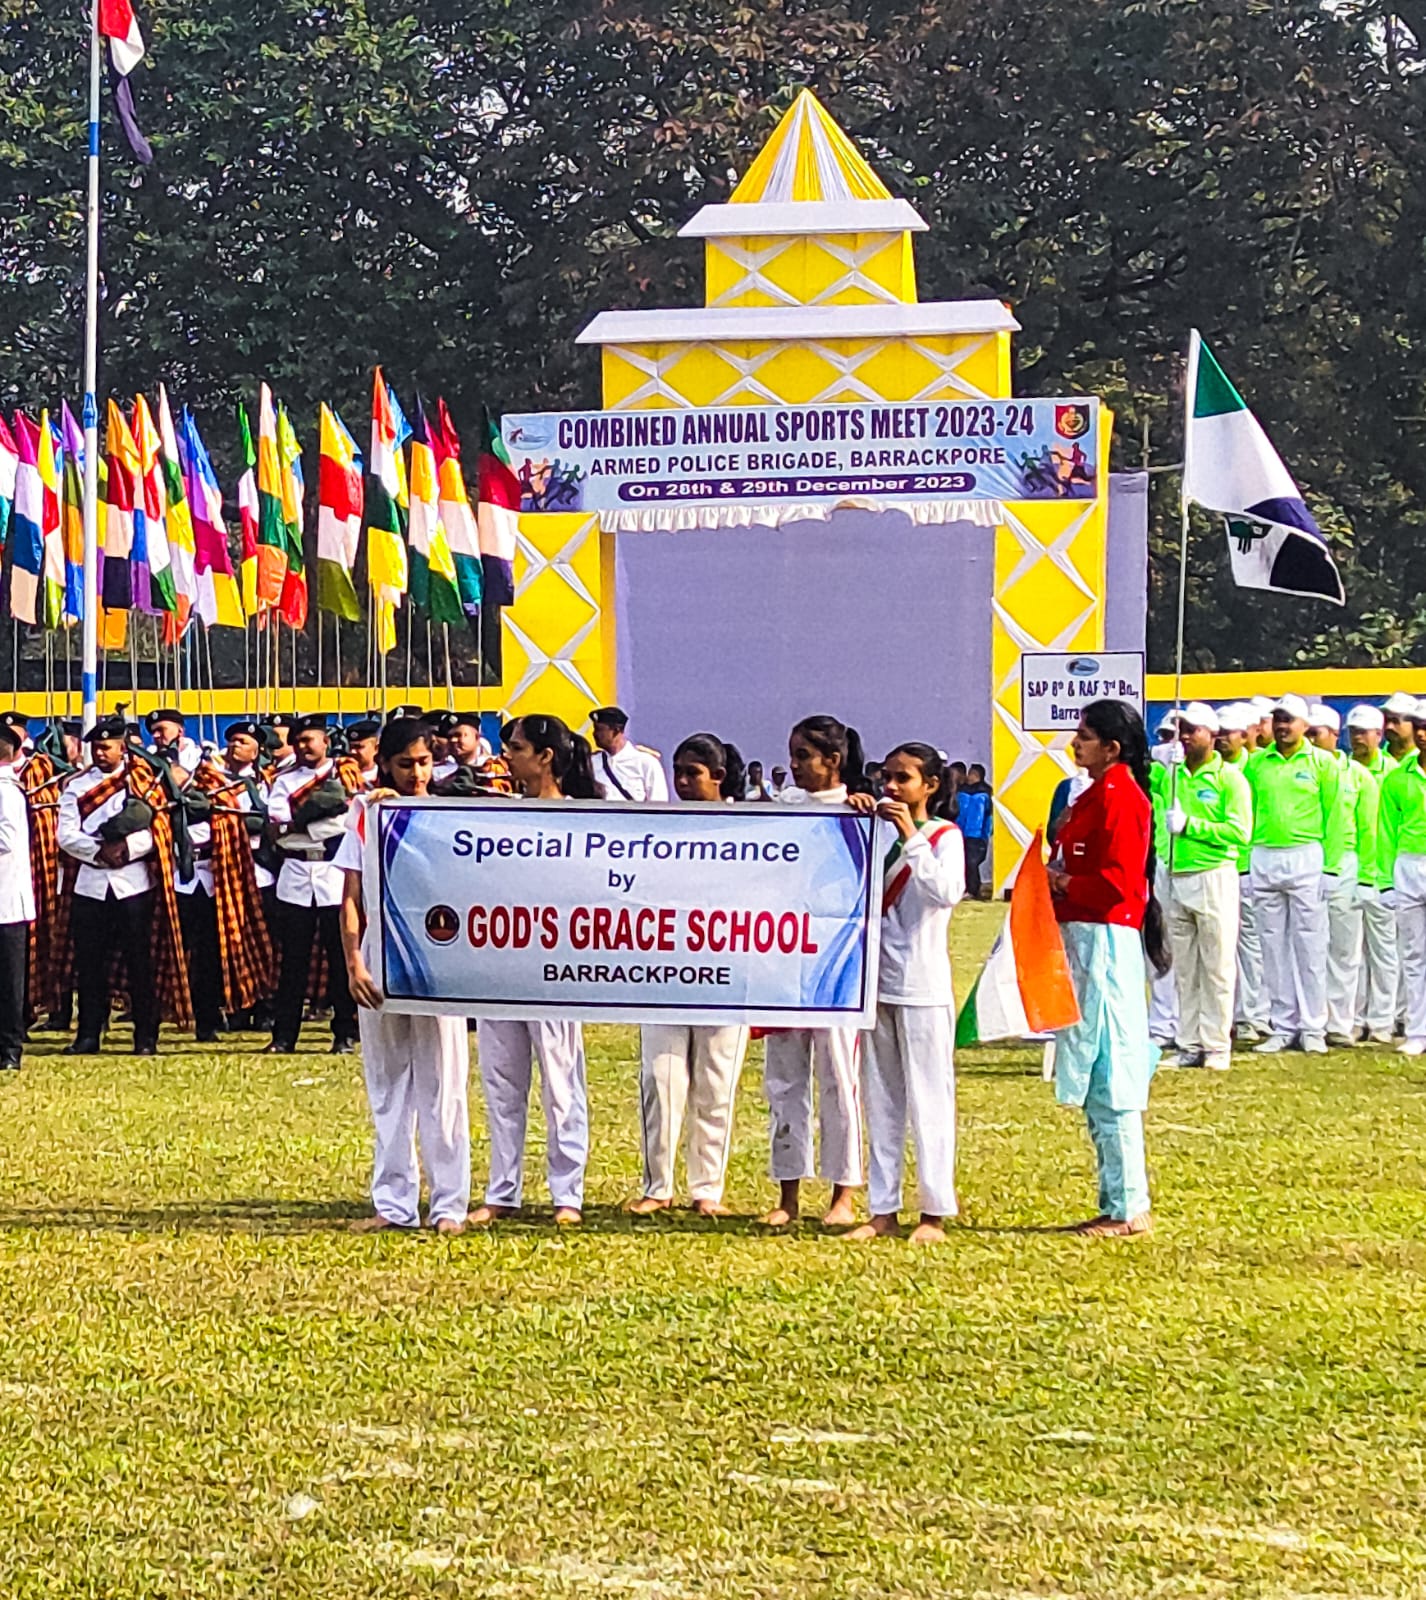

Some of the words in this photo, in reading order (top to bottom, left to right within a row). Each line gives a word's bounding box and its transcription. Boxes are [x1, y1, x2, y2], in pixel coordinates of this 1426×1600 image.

[558, 416, 677, 449] COMBINED
[682, 413, 770, 446] ANNUAL
[775, 409, 865, 442] SPORTS
[871, 408, 929, 440] MEET
[935, 405, 1034, 438] 2023-24
[590, 457, 660, 476] ARMED
[668, 454, 740, 474] POLICE
[747, 451, 843, 472] BRIGADE,
[850, 447, 1006, 468] BARRACKPORE
[628, 484, 659, 498] On
[666, 482, 712, 496] 28th
[719, 482, 736, 495] &
[742, 480, 788, 494] 29th
[796, 477, 908, 492] December
[913, 476, 965, 490] 2023
[1027, 680, 1049, 697] SAP
[1067, 680, 1075, 697] &
[1079, 680, 1100, 697] RAF
[452, 830, 573, 864] Special
[584, 833, 800, 863] Performance
[607, 869, 637, 892] by
[467, 905, 560, 950] GOD'S
[569, 906, 676, 952] GRACE
[686, 909, 818, 955] SCHOOL
[543, 963, 731, 986] BARRACKPORE
